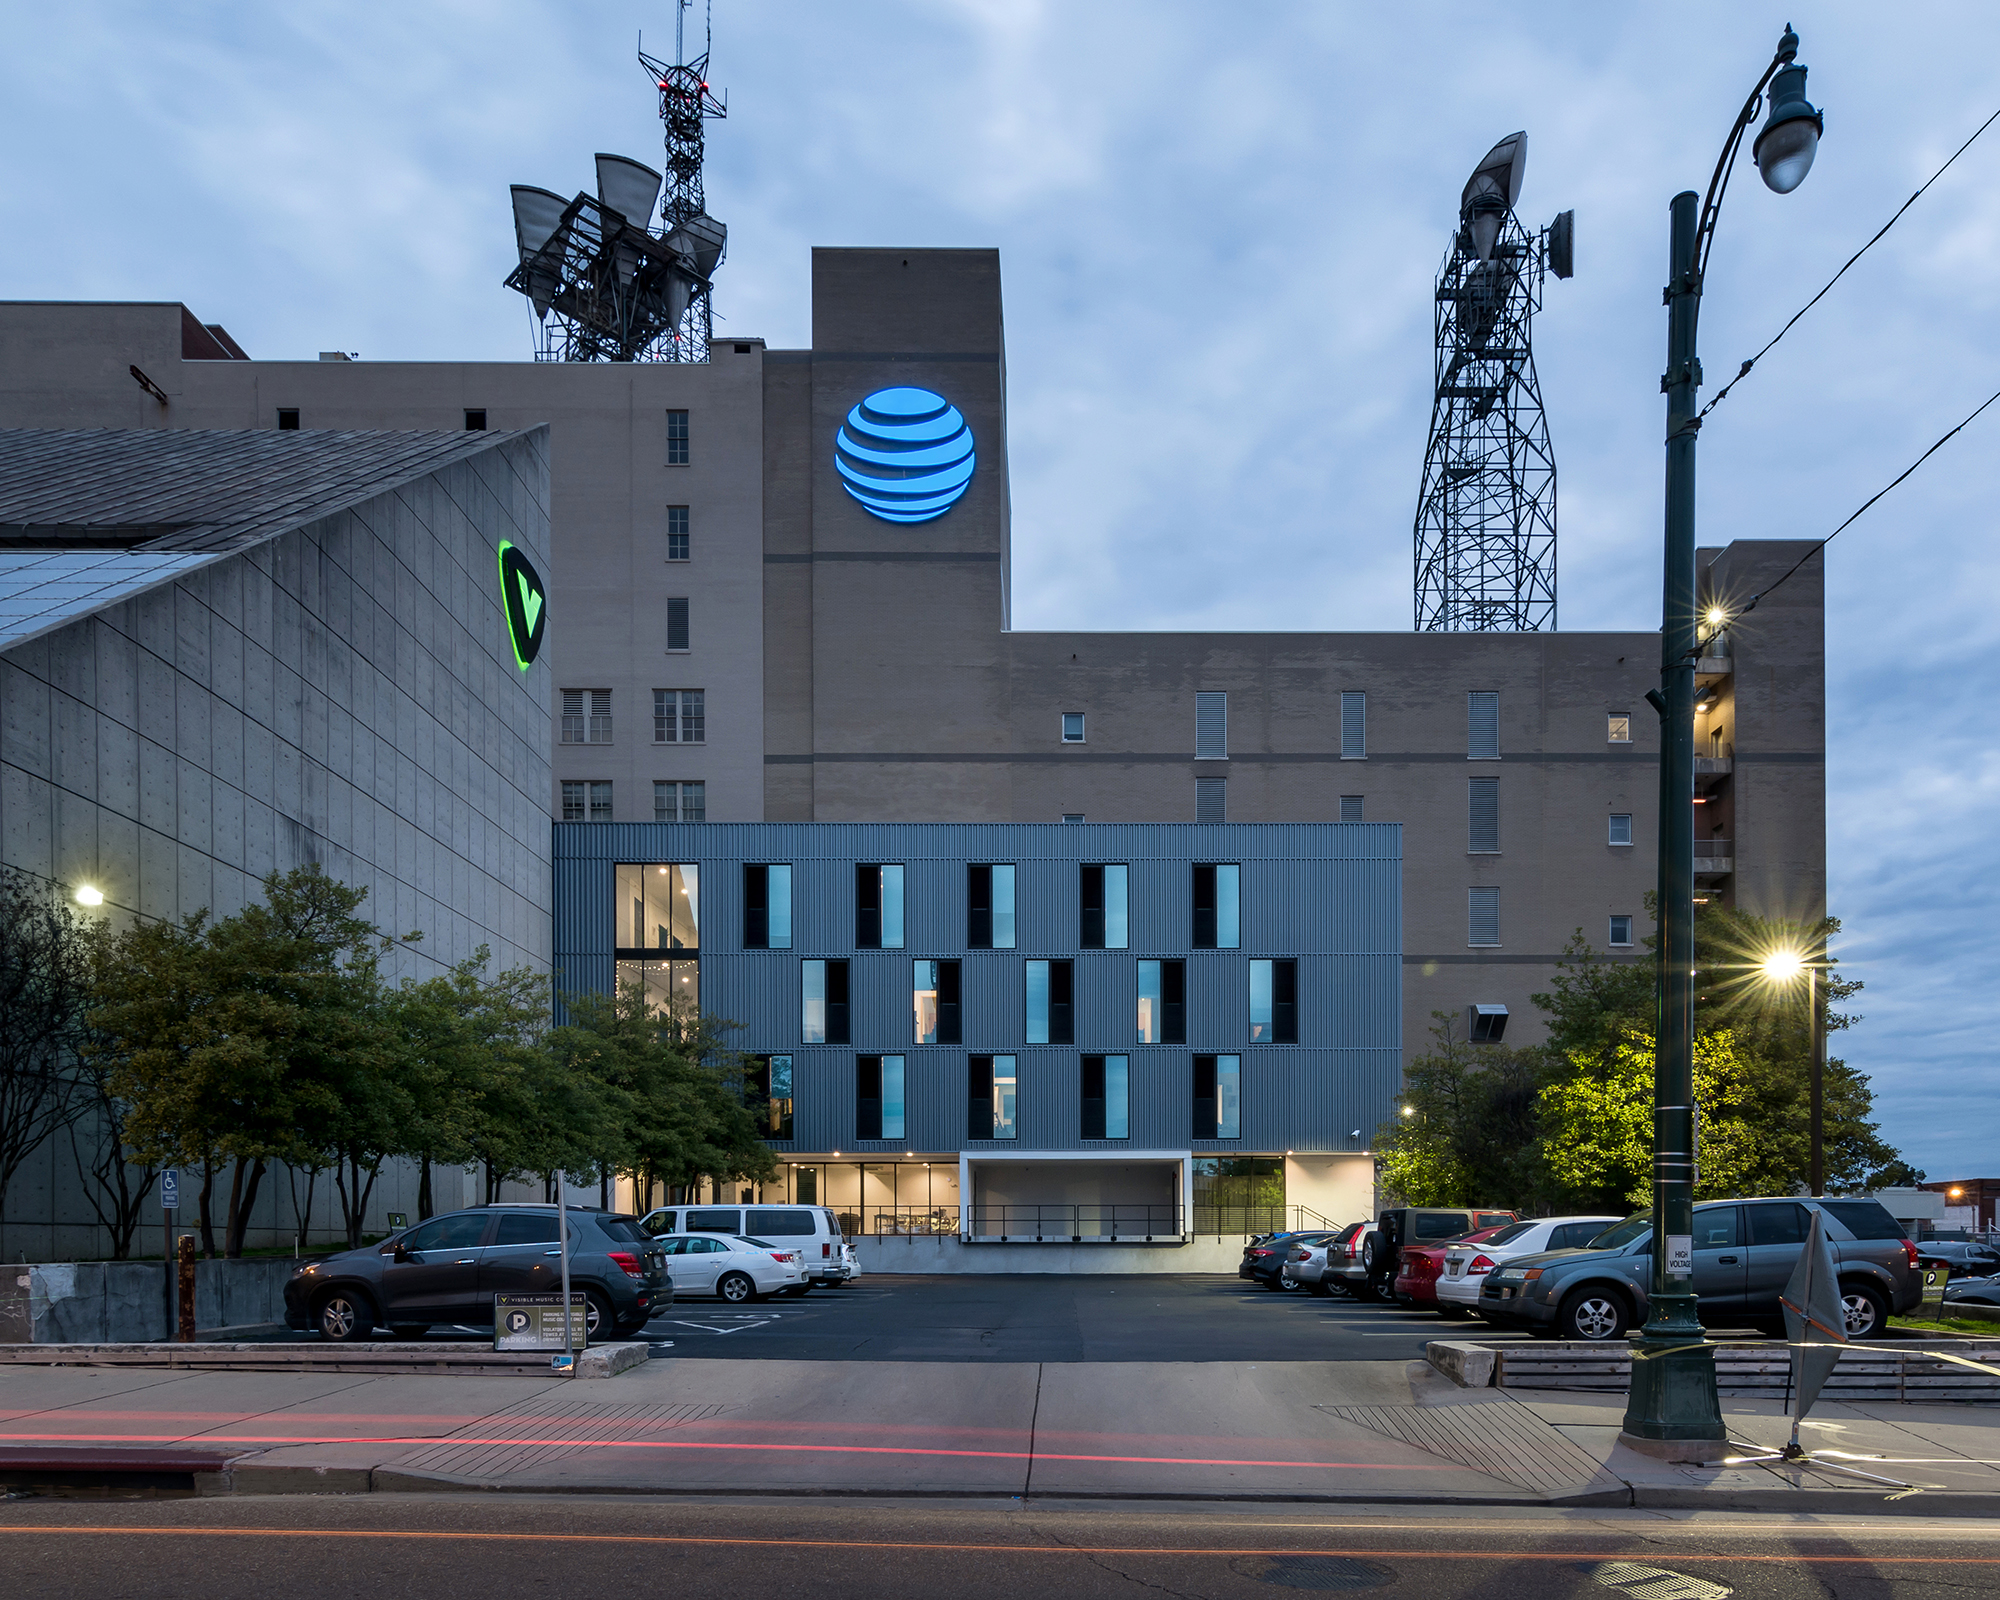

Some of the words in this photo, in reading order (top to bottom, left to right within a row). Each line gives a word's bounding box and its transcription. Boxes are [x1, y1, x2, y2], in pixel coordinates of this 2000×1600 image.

[1674, 1250, 1688, 1258] HIGH
[513, 1314, 527, 1330] P
[500, 1336, 537, 1344] PARKING
